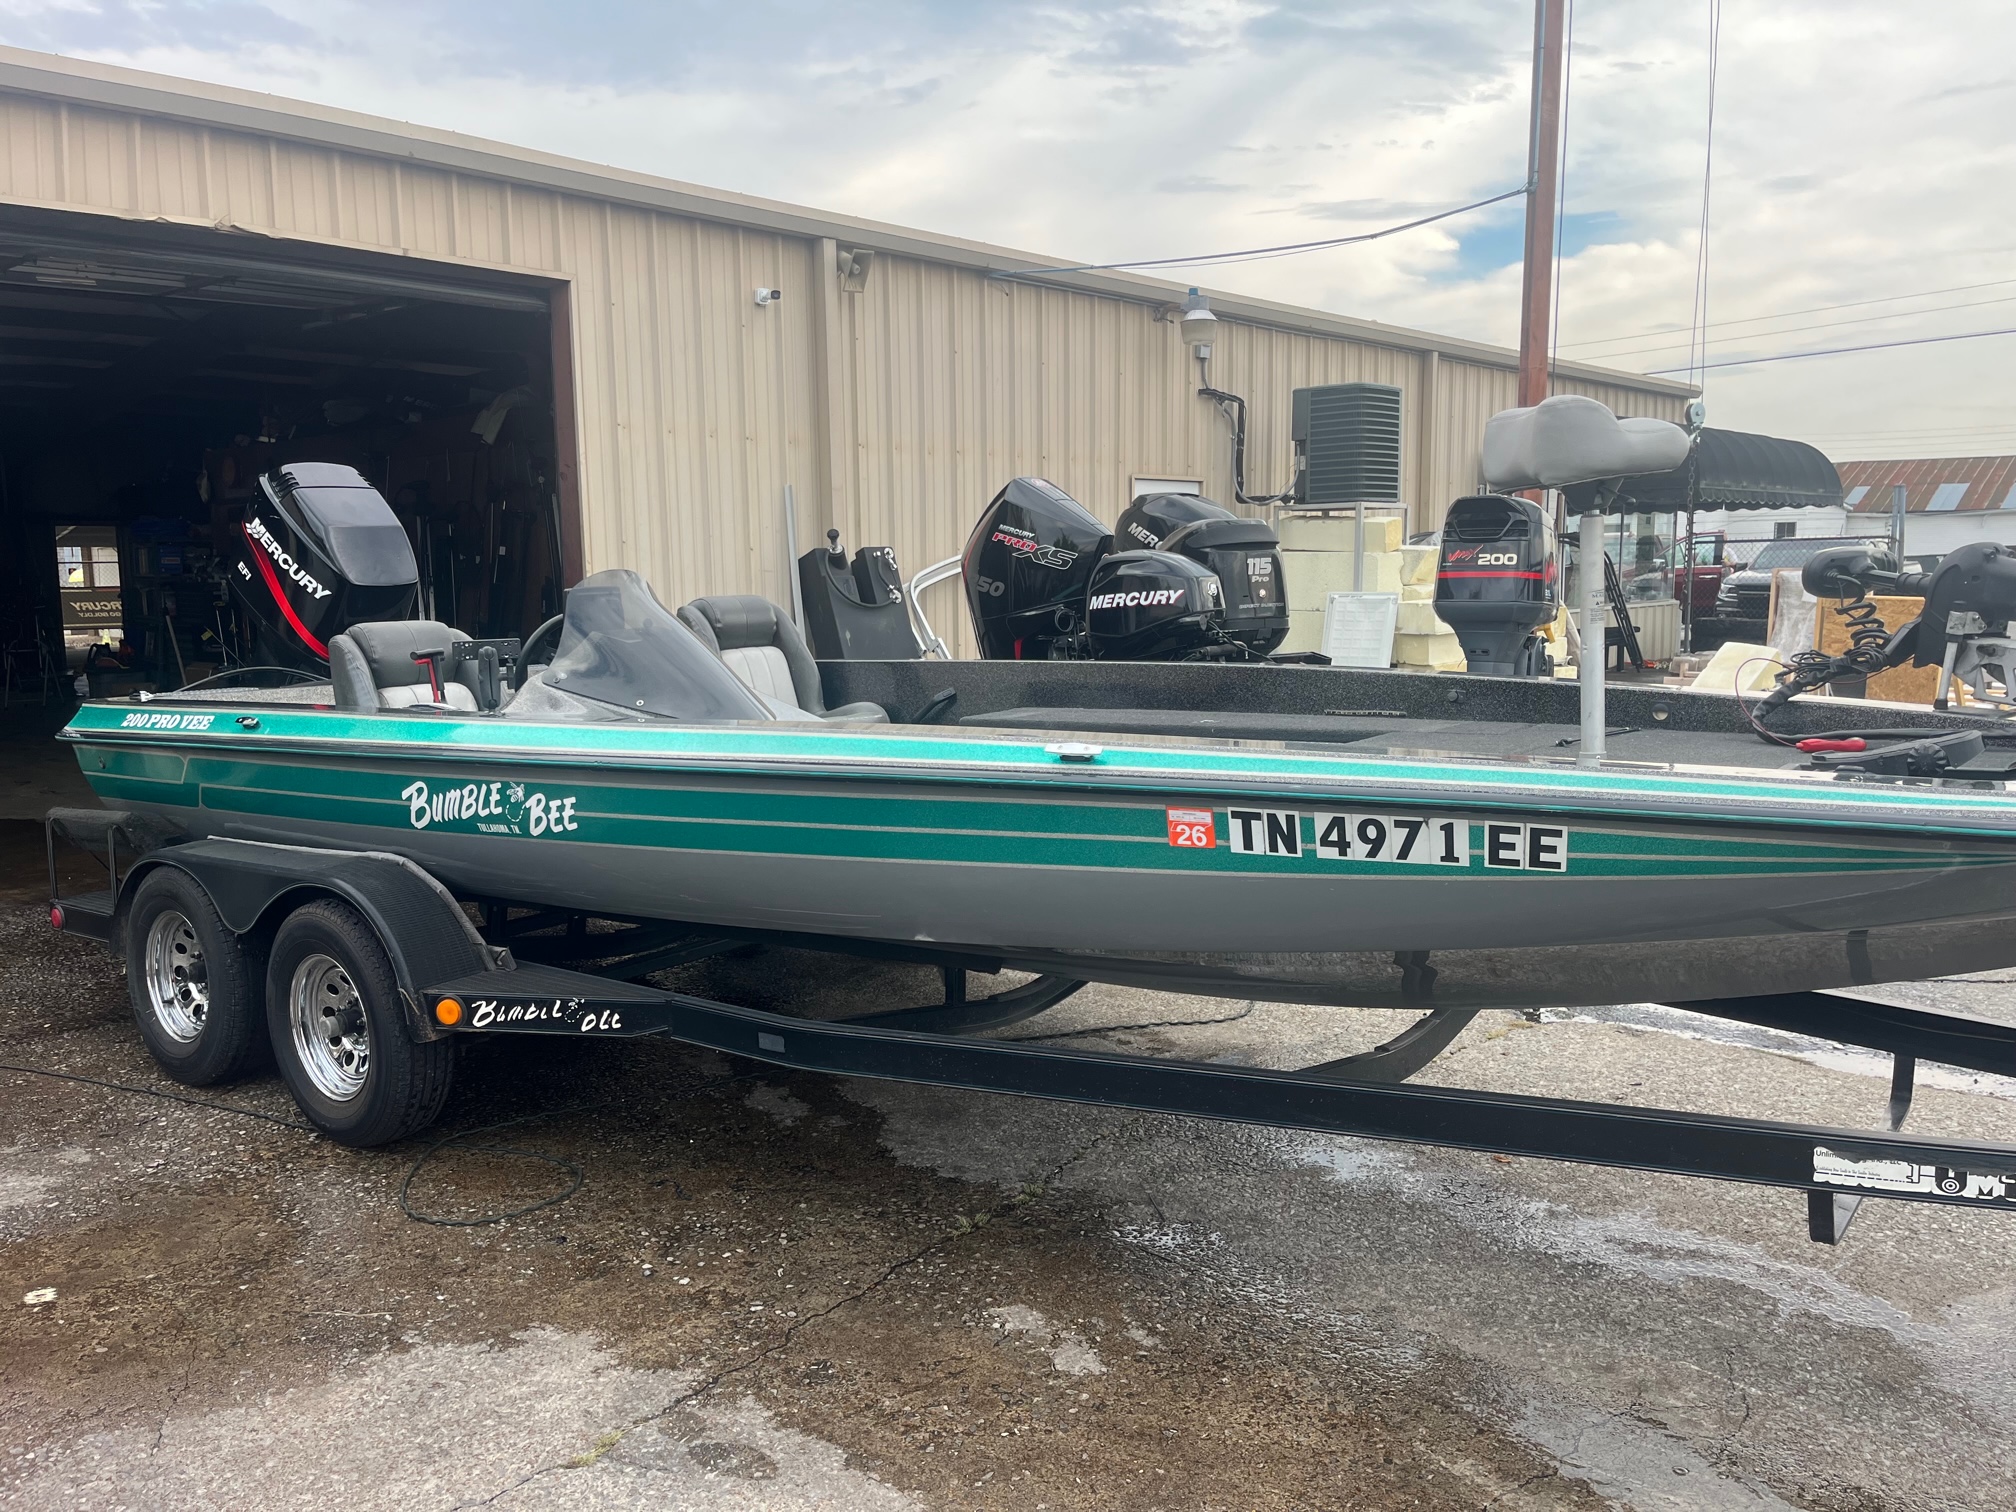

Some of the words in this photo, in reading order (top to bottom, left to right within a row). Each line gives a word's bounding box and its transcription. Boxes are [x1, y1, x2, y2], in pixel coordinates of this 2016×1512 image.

[998, 524, 1036, 539] MERCURY
[992, 532, 1038, 553] PRO
[245, 517, 332, 599] MERCURY
[1012, 544, 1079, 570] XS
[1246, 557, 1272, 575] 115
[1477, 553, 1518, 566] 200
[237, 561, 252, 581] EFI
[1251, 575, 1270, 583] Pro
[1089, 589, 1184, 610] MERCURY
[121, 713, 149, 727] 200
[146, 714, 181, 729] PRO
[179, 715, 215, 730] VEE
[1176, 824, 1207, 847] 26
[1231, 811, 1298, 854] TN
[1319, 816, 1459, 863] 4971
[1487, 825, 1563, 870] EE
